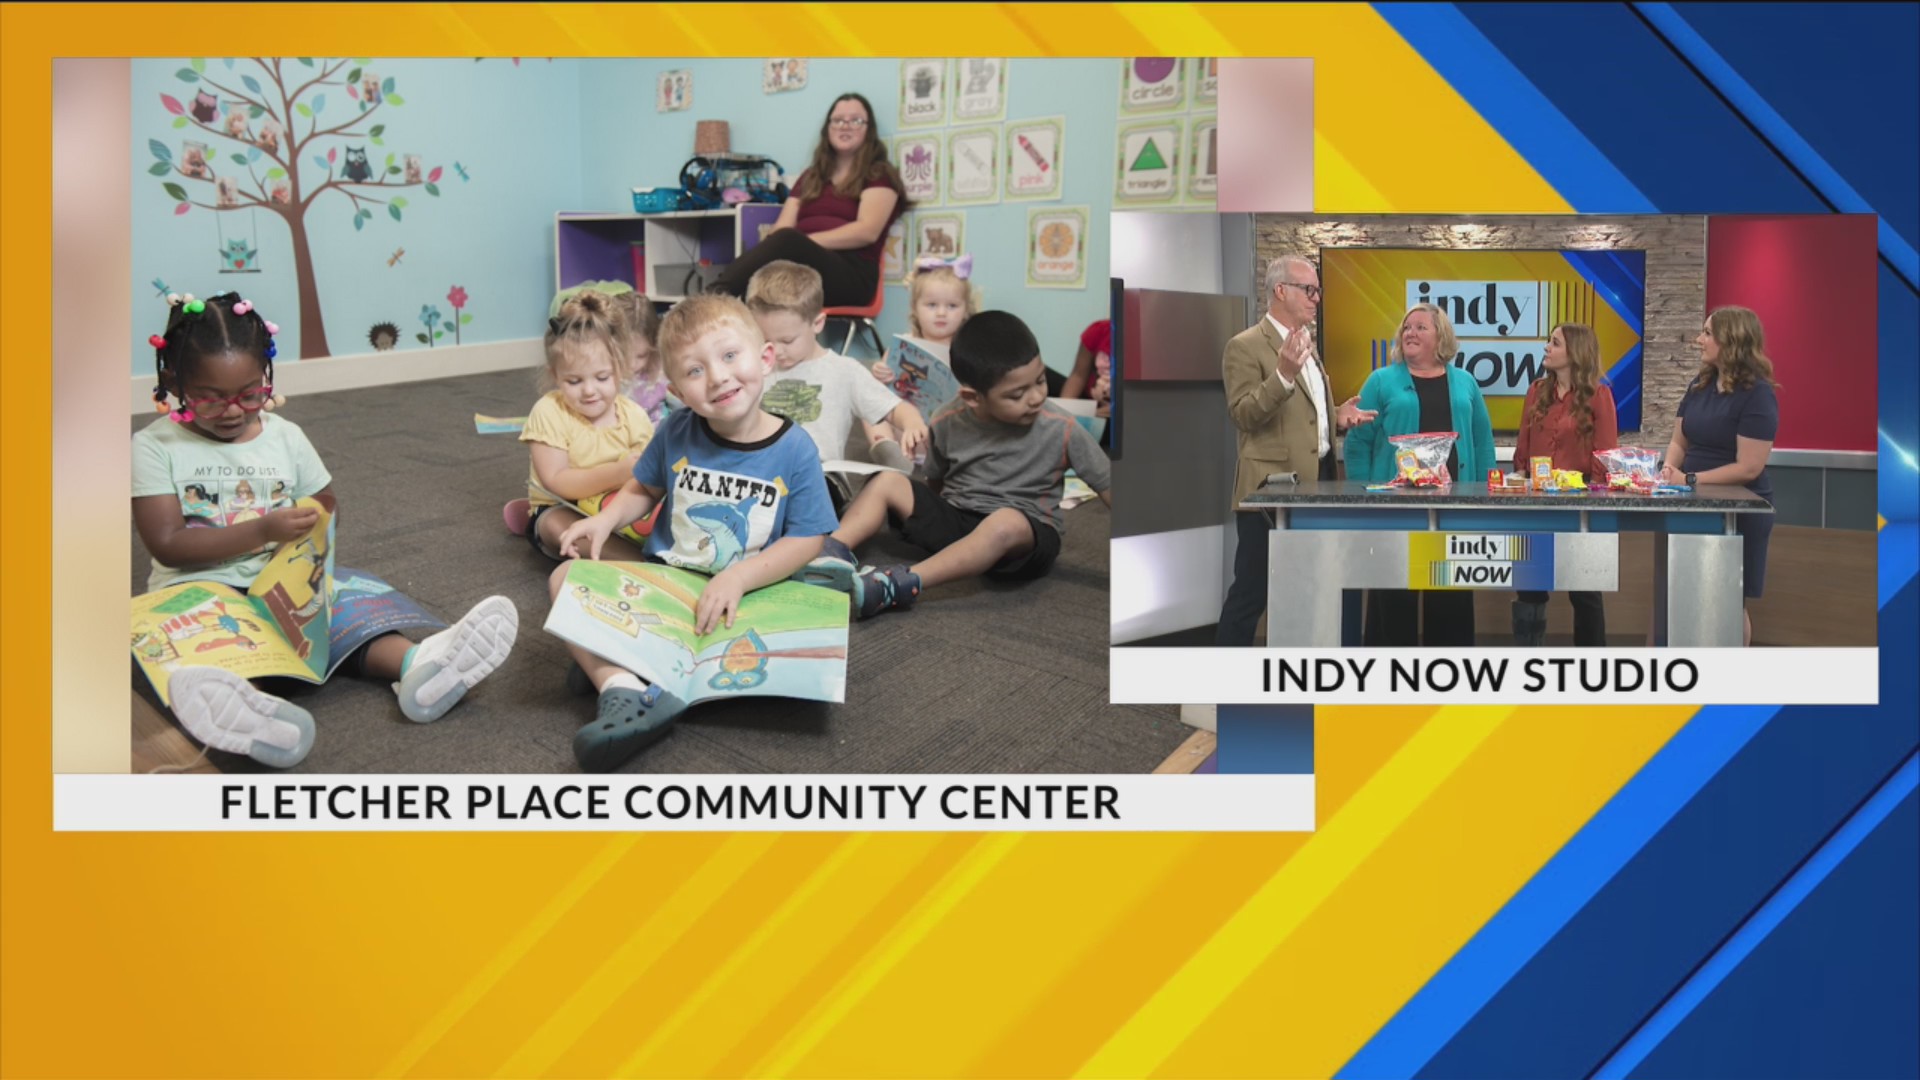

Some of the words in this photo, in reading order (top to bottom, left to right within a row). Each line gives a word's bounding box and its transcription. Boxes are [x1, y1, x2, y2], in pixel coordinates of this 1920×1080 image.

[1131, 84, 1175, 100] circle
[907, 101, 936, 115] black
[1018, 173, 1045, 188] pink
[1127, 179, 1168, 189] triangle
[1037, 260, 1075, 272] orange
[1454, 351, 1547, 388] OW
[194, 467, 214, 476] MY
[218, 466, 232, 476] TO
[237, 466, 256, 476] DO
[679, 468, 777, 507] WANTED
[1451, 535, 1503, 560] indy
[1455, 566, 1512, 583] NOW
